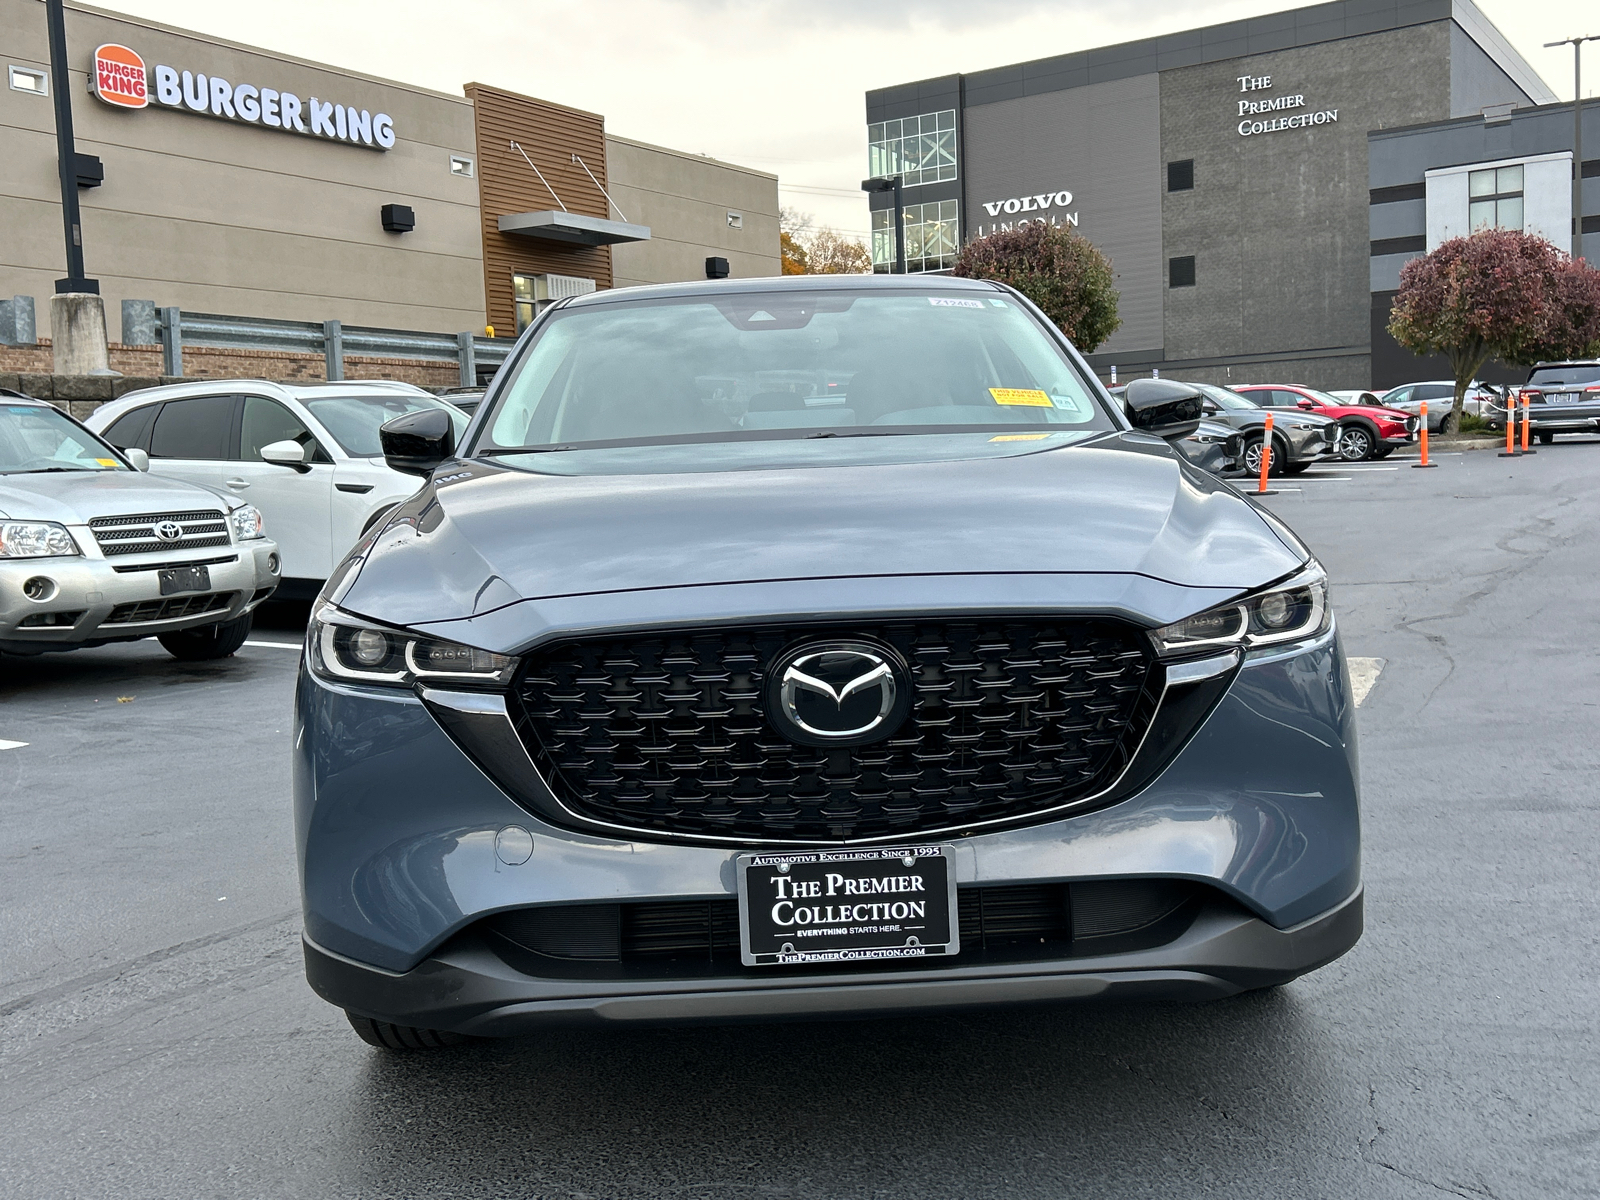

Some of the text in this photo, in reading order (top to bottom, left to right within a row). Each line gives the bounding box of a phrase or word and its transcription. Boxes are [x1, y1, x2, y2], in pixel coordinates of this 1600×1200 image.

[97, 59, 145, 79] BURGER
[98, 72, 146, 98] KING
[1237, 75, 1272, 93] THE
[155, 64, 396, 149] BURGER KING
[1237, 93, 1306, 117] PREMIER
[1237, 108, 1339, 137] COLLECTION
[982, 190, 1073, 217] VOLVO
[752, 847, 940, 865] AUTOMOTIVE EXCELLENCE SINCE 1995
[770, 873, 925, 899] THE PREMIER
[771, 900, 926, 926] COLLECTION
[797, 927, 848, 938] EVERYTHING
[849, 925, 878, 934] STARTS
